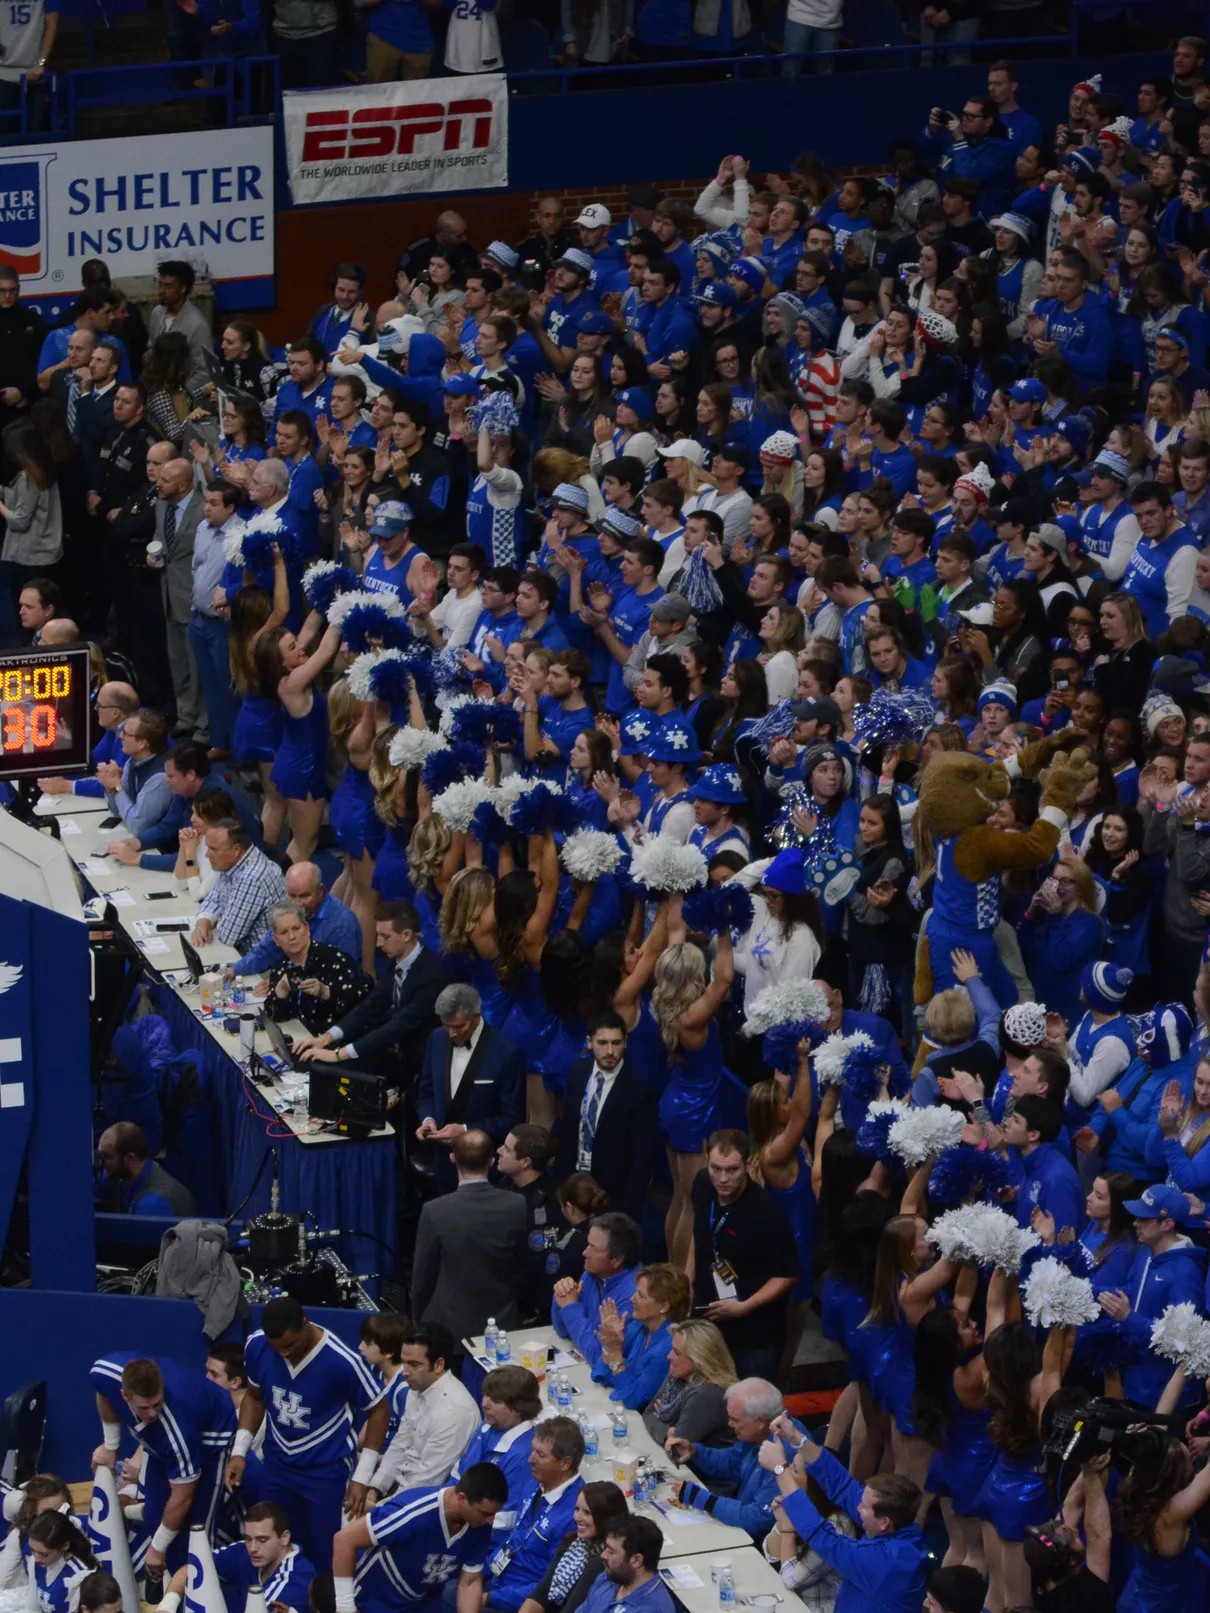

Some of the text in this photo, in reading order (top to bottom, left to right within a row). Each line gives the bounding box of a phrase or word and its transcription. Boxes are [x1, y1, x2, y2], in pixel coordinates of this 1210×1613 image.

[9, 5, 31, 25] 15
[456, 0, 482, 21] 24
[302, 98, 493, 162] ESPN
[300, 155, 487, 179] THE WORLDWIDE LEADER IN SPORTS
[68, 165, 264, 215] SHELTER
[68, 215, 265, 256] INSURANCE
[0, 665, 70, 702] 0:00
[3, 704, 57, 750] 30
[271, 1385, 312, 1430] UK
[422, 1553, 460, 1584] UK
